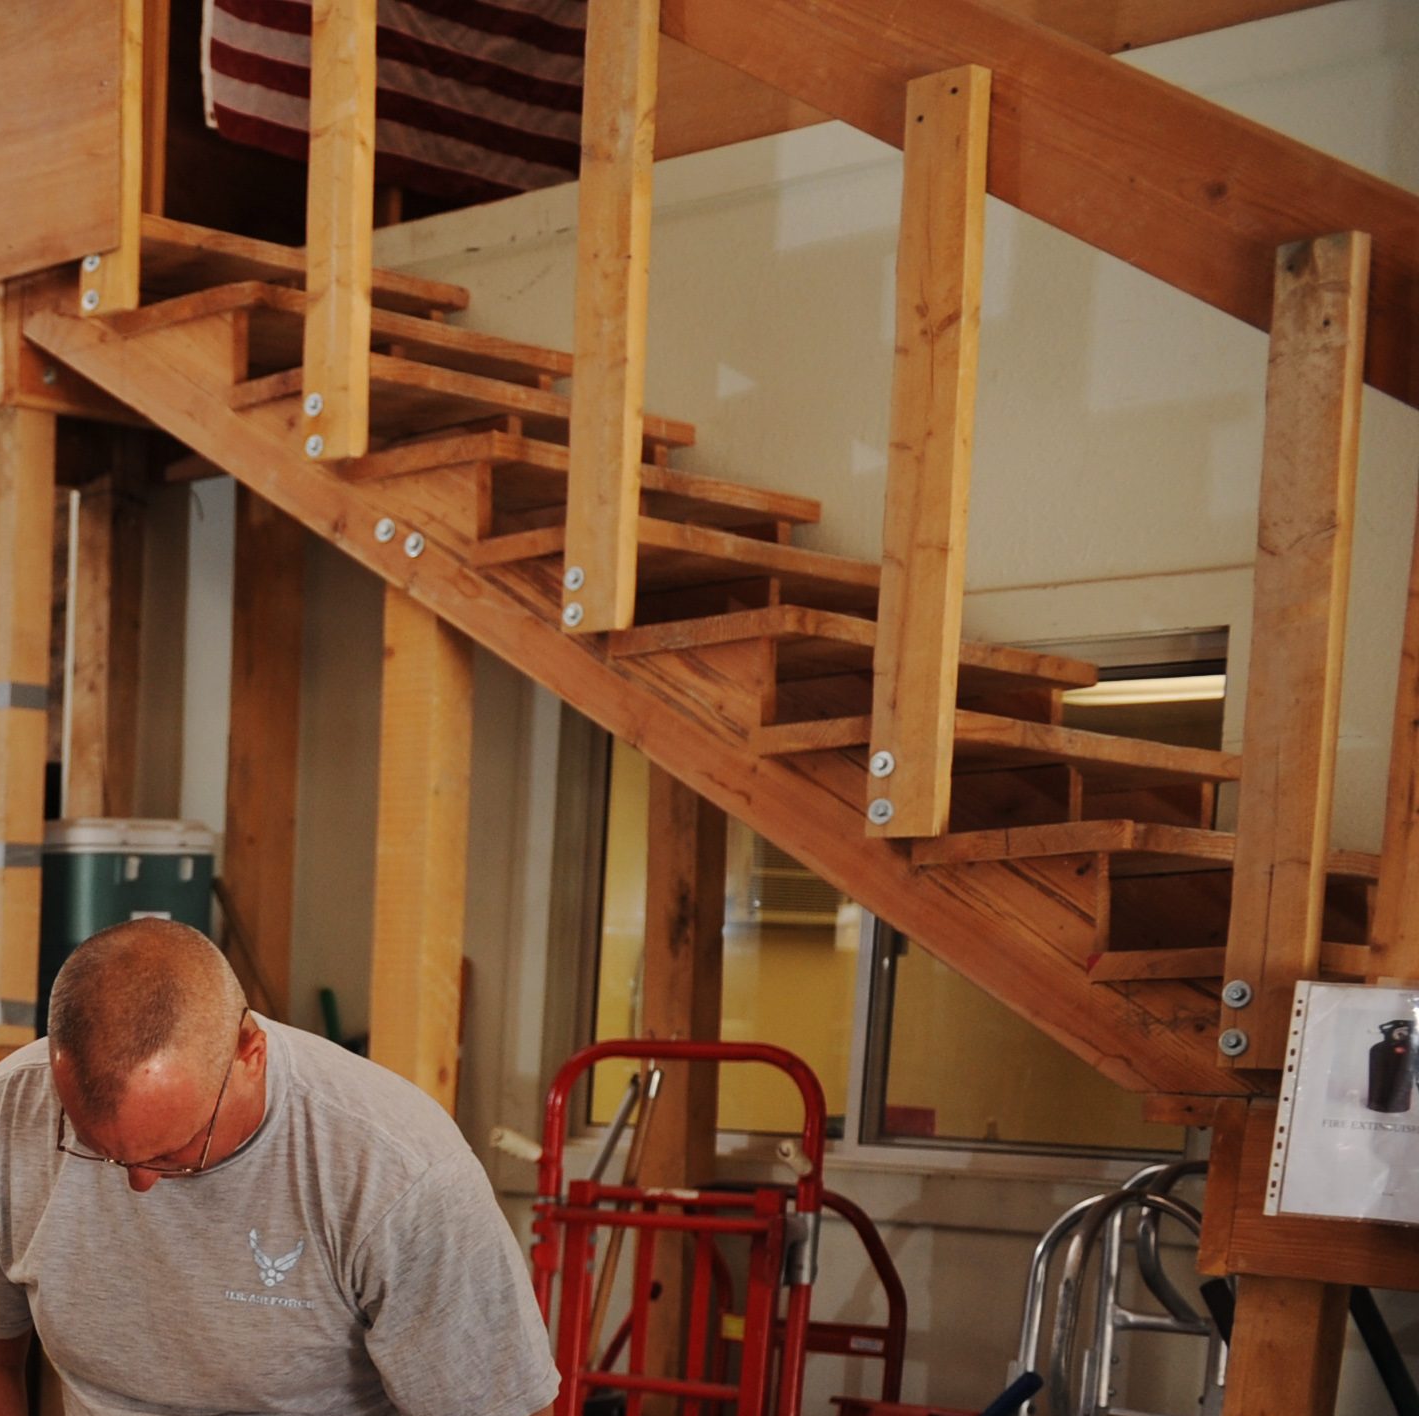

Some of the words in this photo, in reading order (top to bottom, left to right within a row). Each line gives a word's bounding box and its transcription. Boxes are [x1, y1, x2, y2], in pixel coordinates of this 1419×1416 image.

[1322, 1118, 1348, 1129] FIRE
[248, 1294, 268, 1305] AIR
[269, 1296, 315, 1310] FORCE
